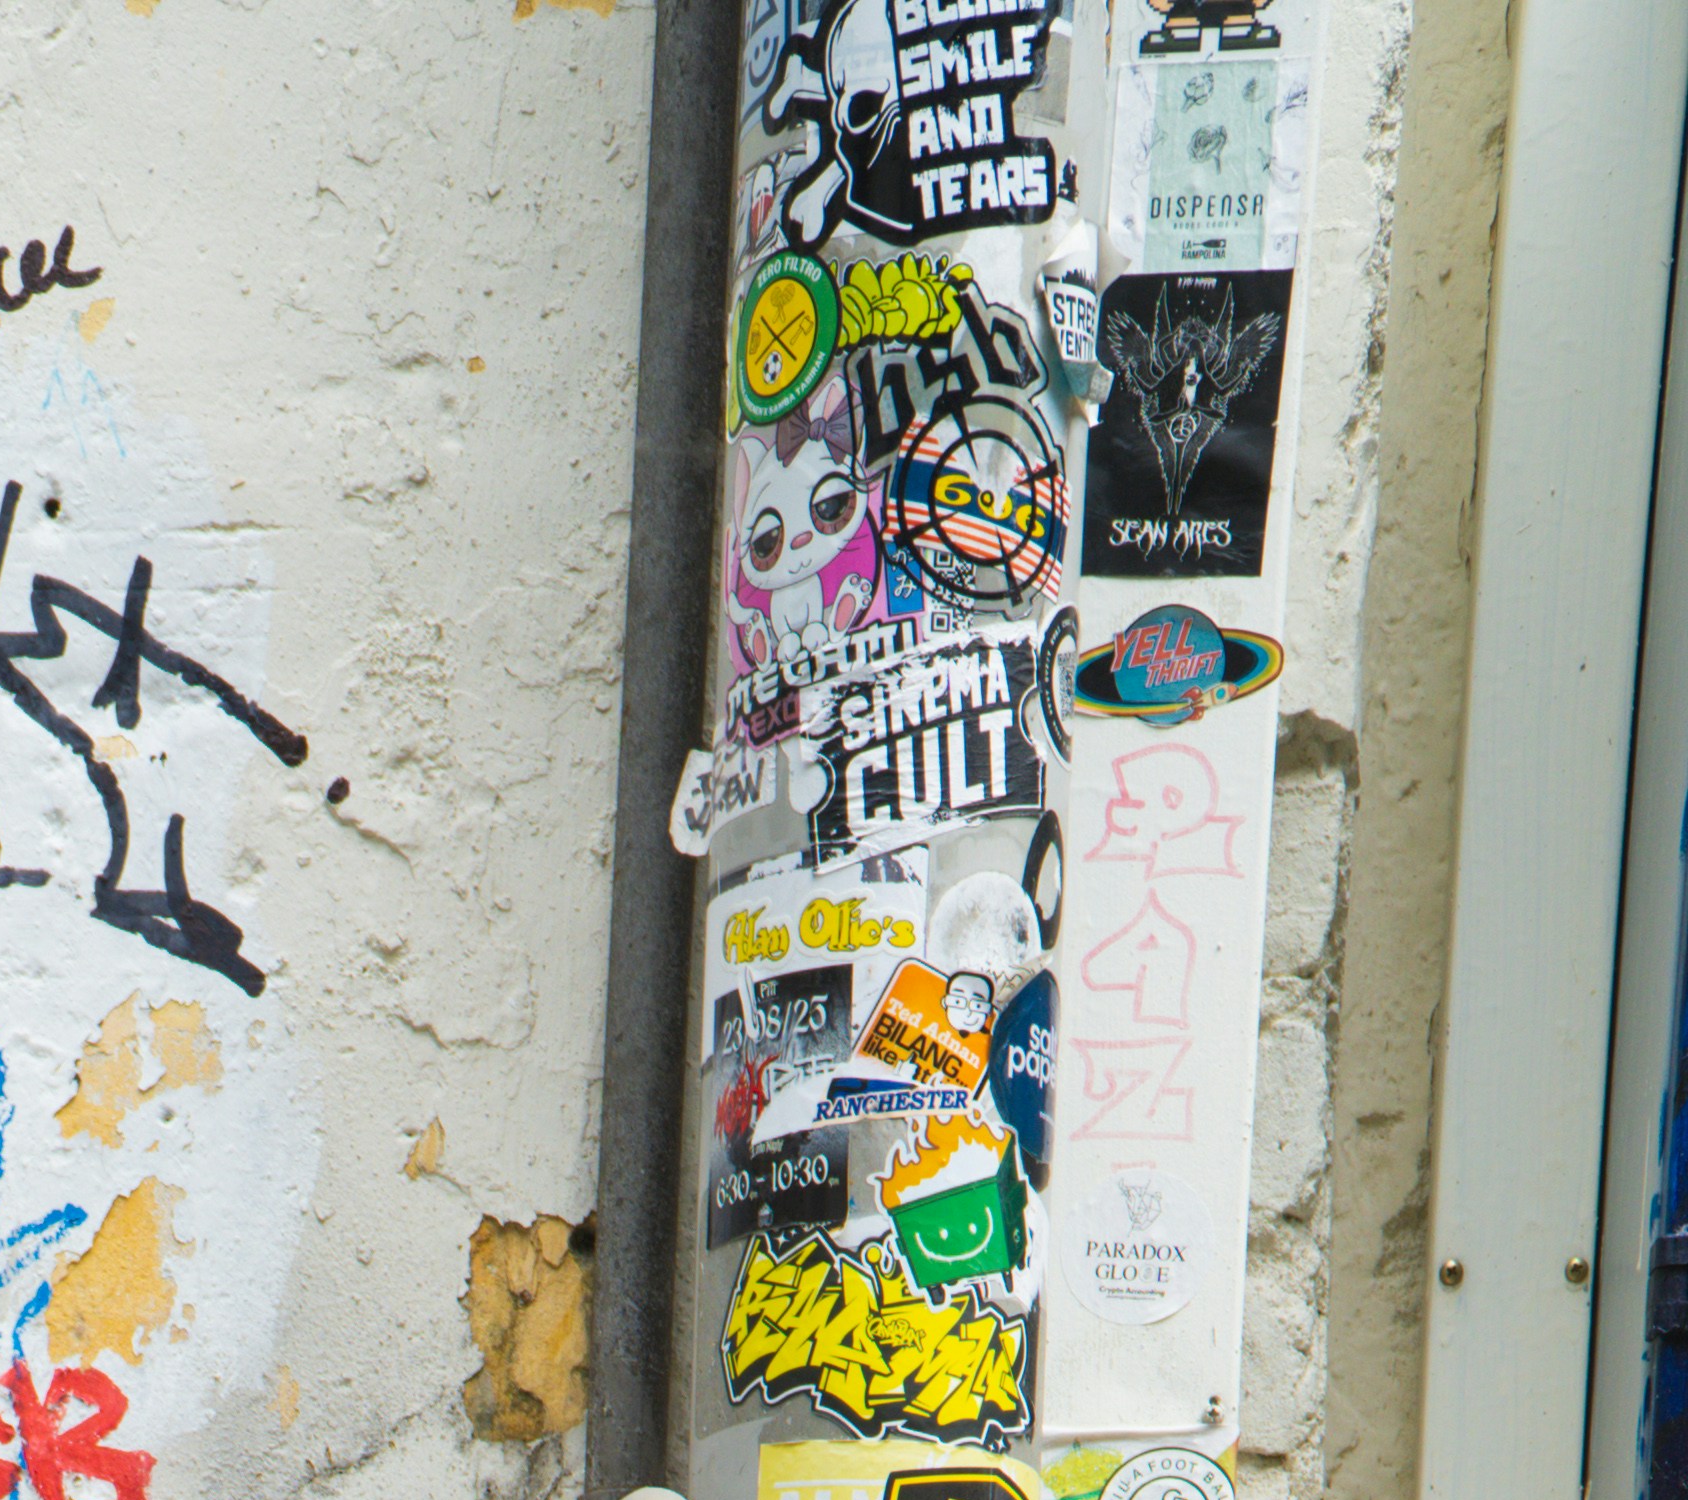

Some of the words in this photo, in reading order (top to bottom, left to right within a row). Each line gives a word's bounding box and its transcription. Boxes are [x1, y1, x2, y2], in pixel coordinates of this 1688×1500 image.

[900, 25, 1039, 98] SMILE
[909, 93, 1004, 159] AND
[912, 156, 1049, 220] TEARS
[1110, 617, 1194, 674] YELL
[1145, 650, 1222, 688] THRIFT
[846, 709, 1013, 836] CULT
[886, 998, 924, 1028] Ted
[923, 1022, 980, 1069] Adnan
[772, 1154, 829, 1193] 10:30
[1086, 1240, 1188, 1262] PARADOX
[1147, 1458, 1198, 1474] FOOT
